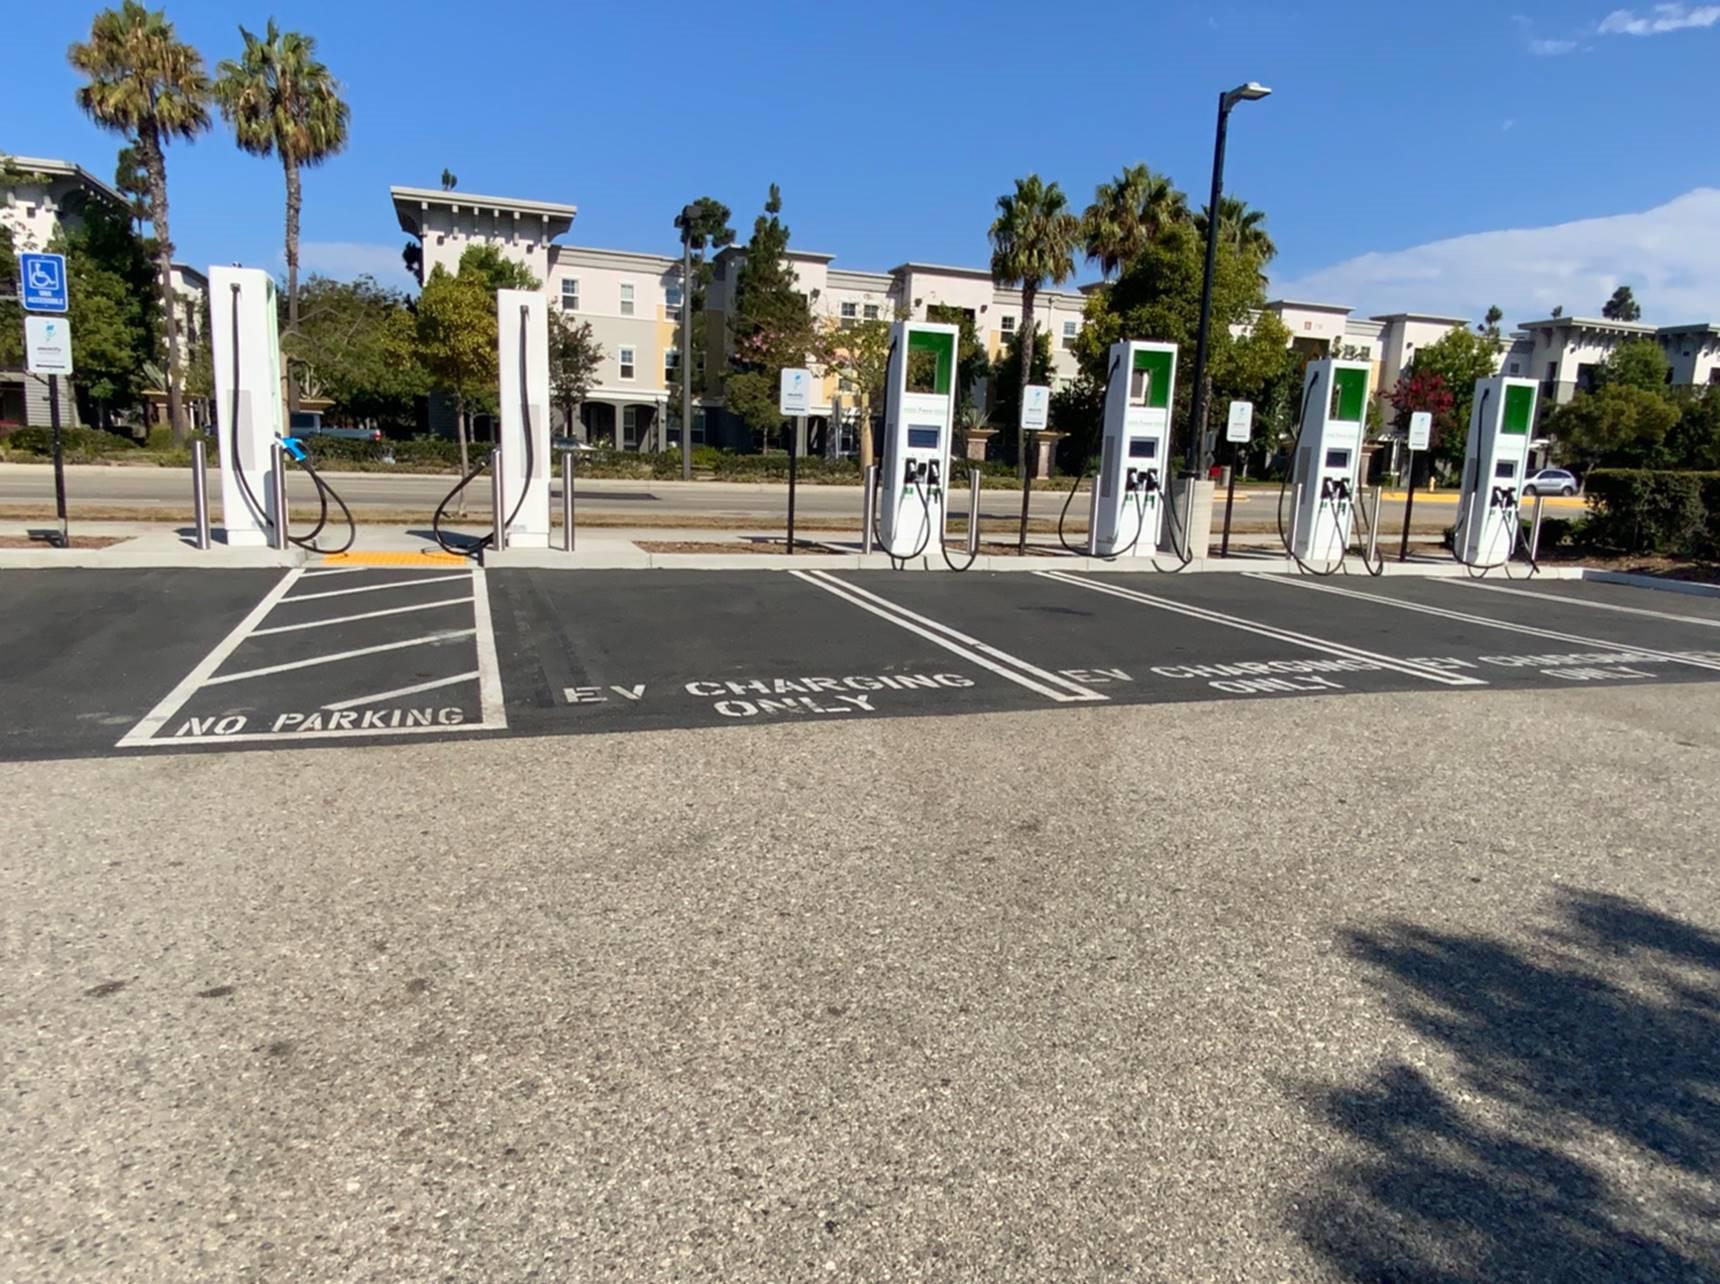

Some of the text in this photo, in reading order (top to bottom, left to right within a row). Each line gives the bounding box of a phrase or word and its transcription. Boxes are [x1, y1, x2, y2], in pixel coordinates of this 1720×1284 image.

[1058, 660, 1382, 682] EV CHARGING
[563, 673, 975, 703] EV CHARGING
[1209, 675, 1344, 693] ONLY
[714, 695, 876, 717] ONLY
[175, 707, 464, 736] NO PARKING
